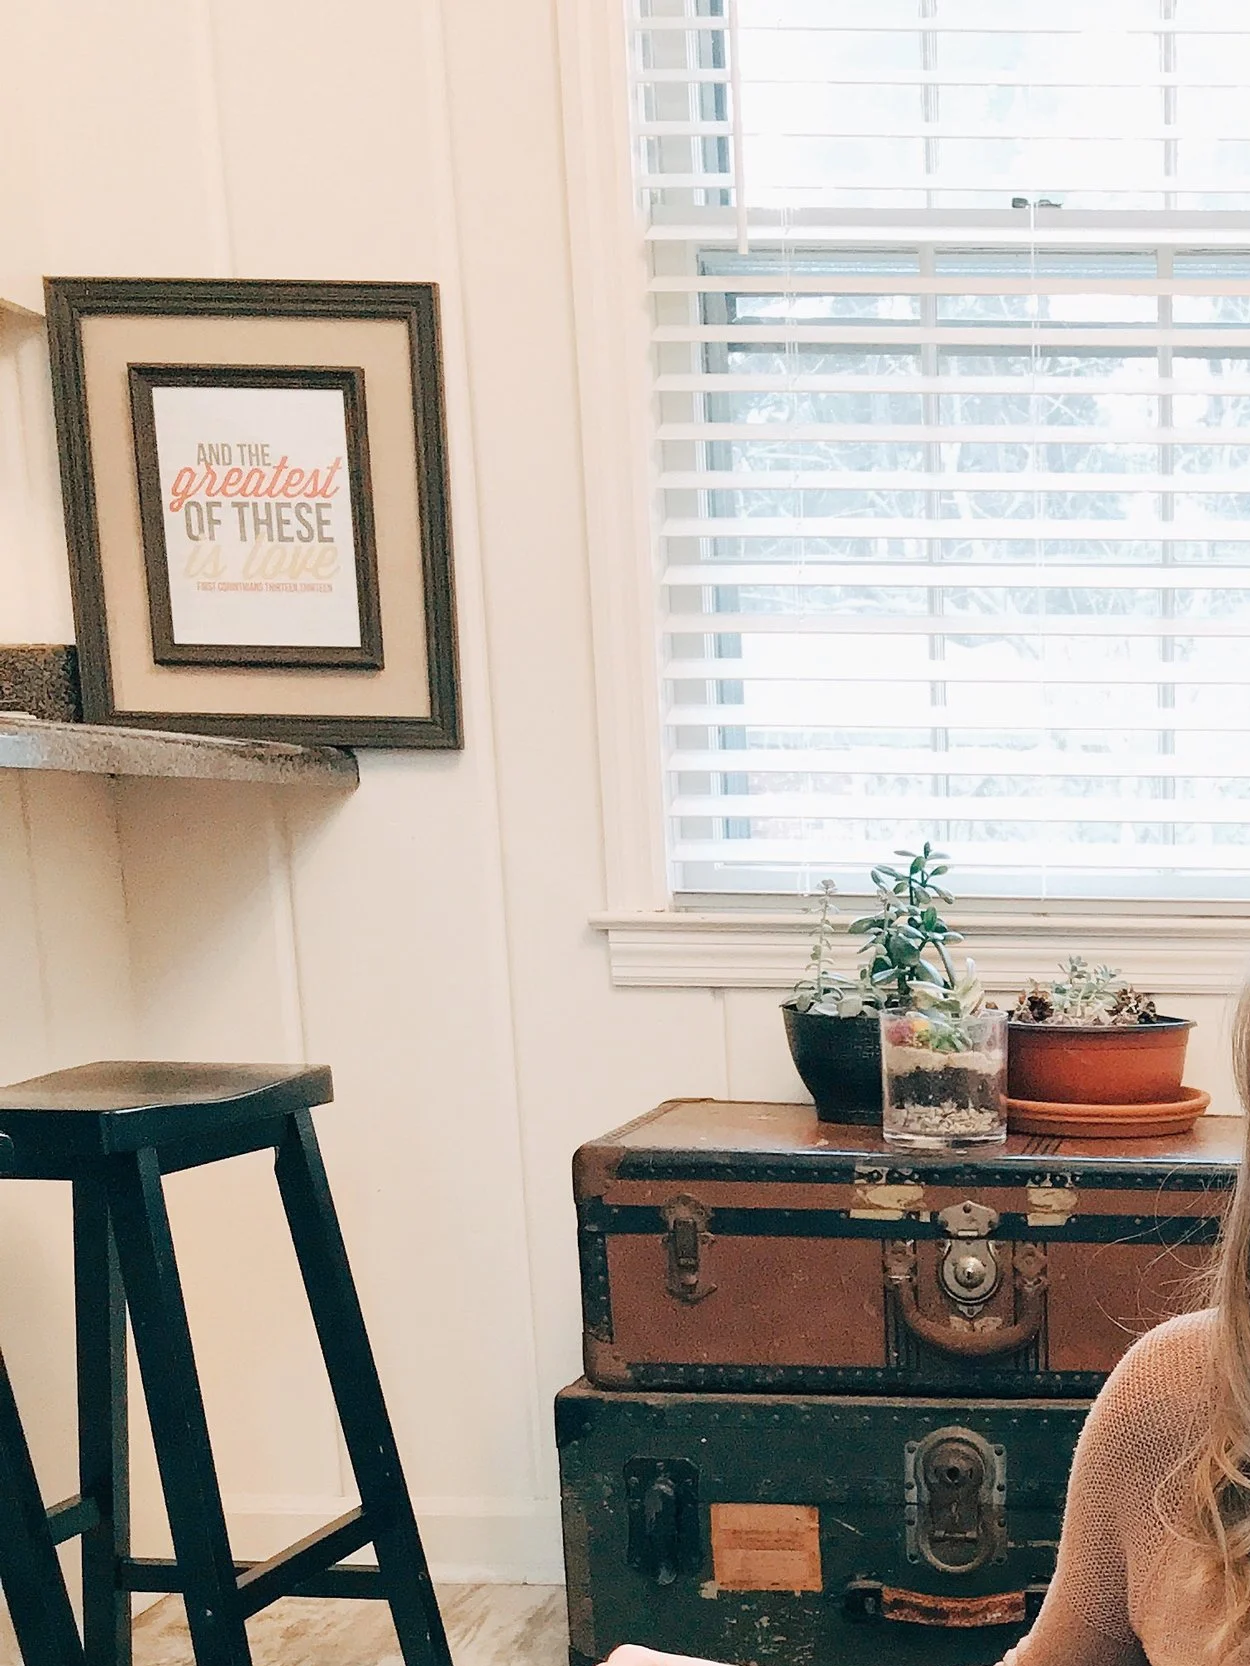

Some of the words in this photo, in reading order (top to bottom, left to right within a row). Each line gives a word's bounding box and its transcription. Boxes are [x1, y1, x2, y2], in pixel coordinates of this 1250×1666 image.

[197, 443, 232, 466] AND
[237, 444, 272, 466] THE
[169, 455, 343, 512] greatest
[184, 501, 222, 541] OF
[231, 502, 334, 543] THESE
[184, 543, 227, 579] is
[242, 532, 341, 579] love
